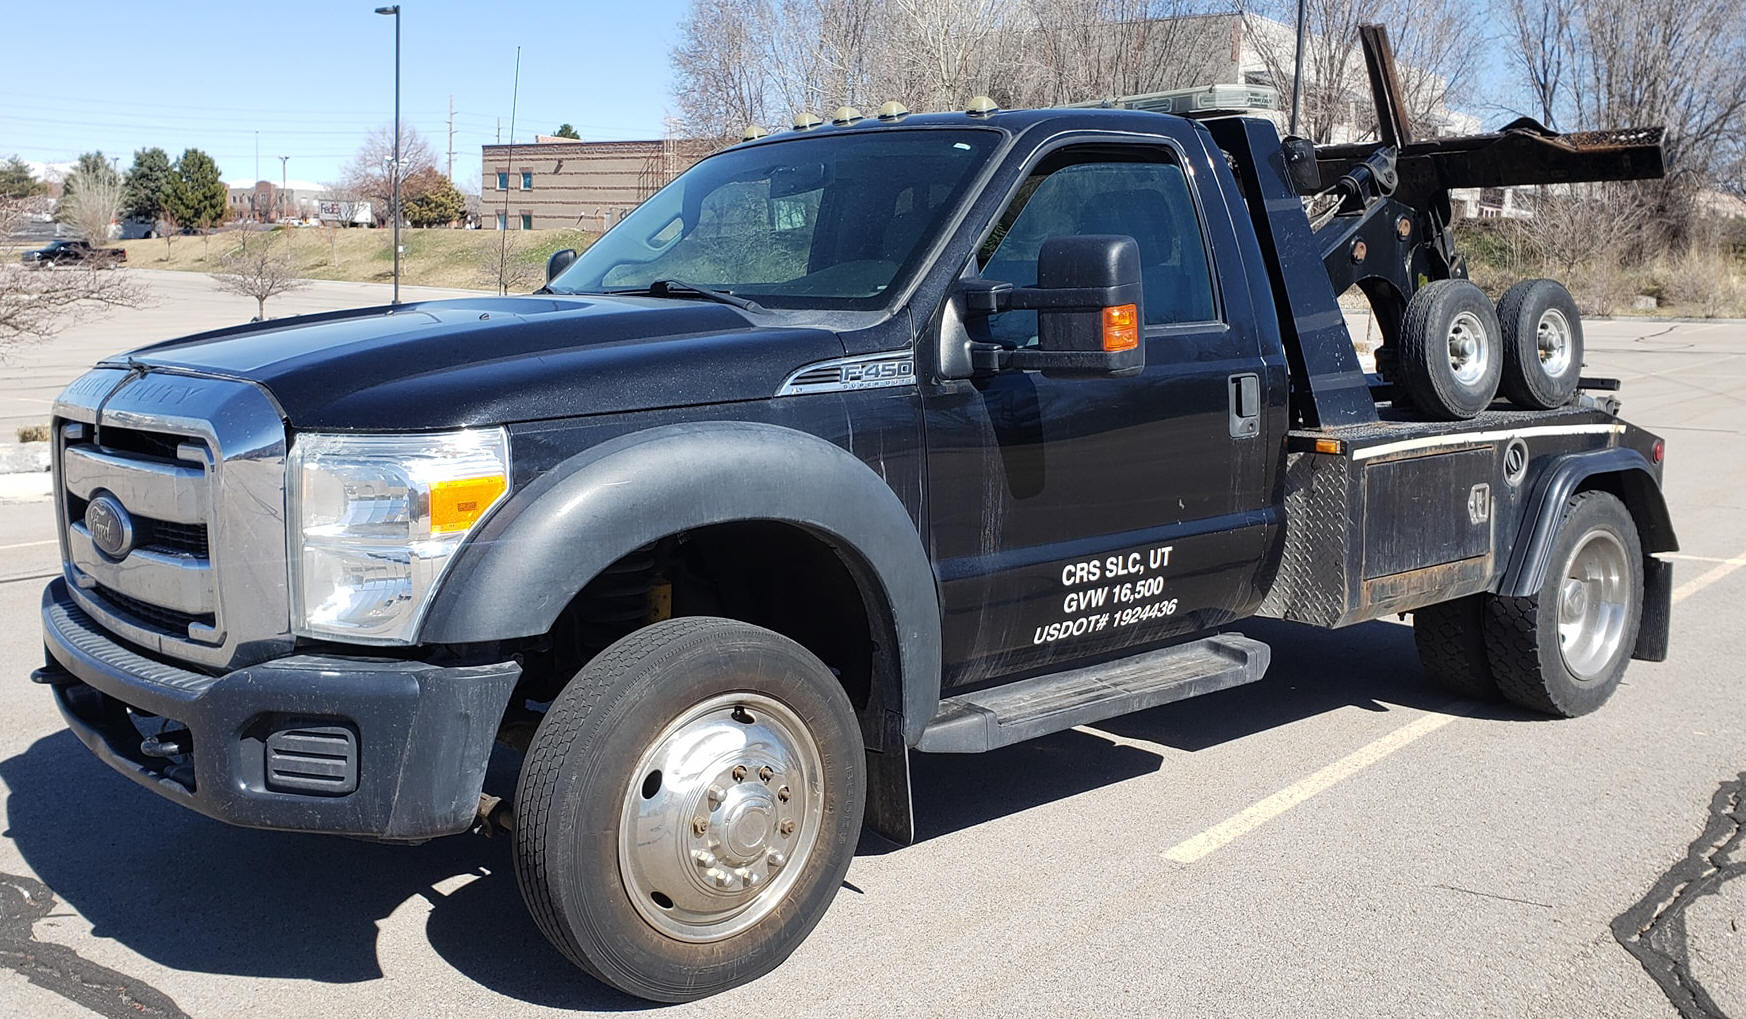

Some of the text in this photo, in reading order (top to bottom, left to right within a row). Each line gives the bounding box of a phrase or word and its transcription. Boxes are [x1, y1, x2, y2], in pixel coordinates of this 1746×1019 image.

[840, 361, 914, 384] F-450
[91, 506, 112, 543] Ford
[1062, 546, 1173, 586] CRS SLC, UT
[1063, 576, 1164, 613] GVW 16,500
[1033, 598, 1178, 645] USDOT# 1924436
